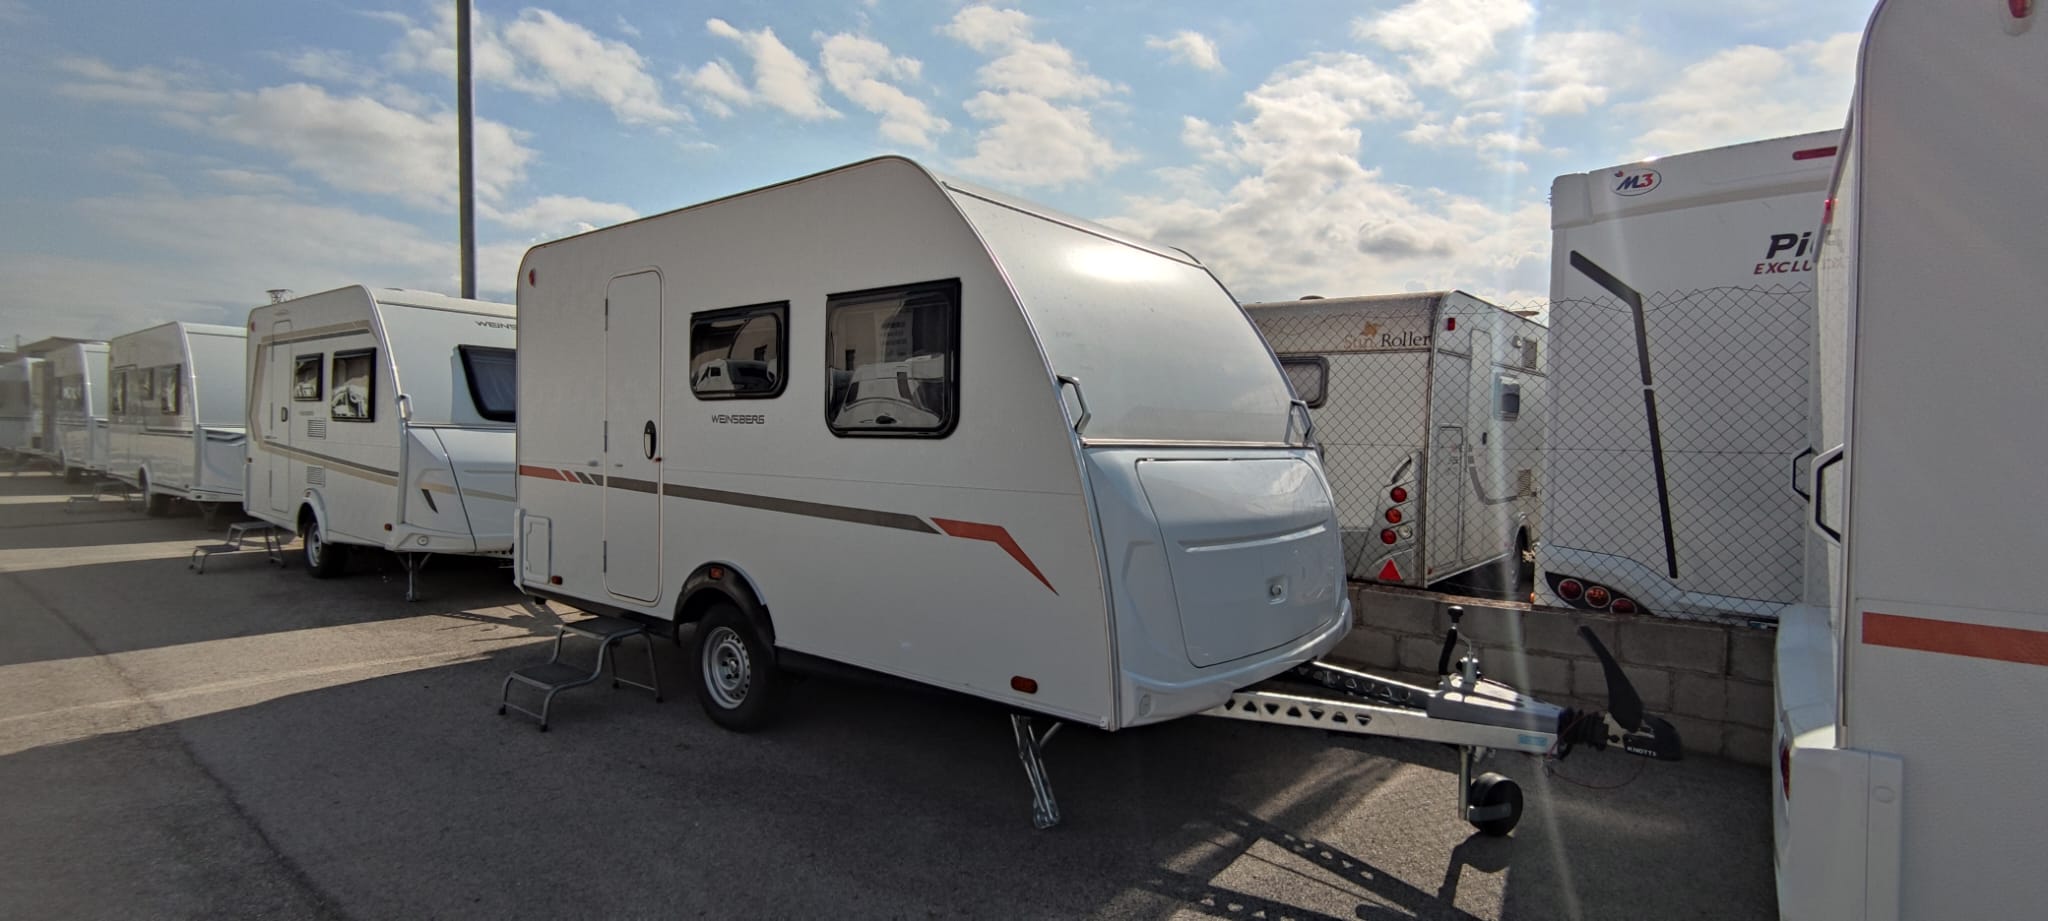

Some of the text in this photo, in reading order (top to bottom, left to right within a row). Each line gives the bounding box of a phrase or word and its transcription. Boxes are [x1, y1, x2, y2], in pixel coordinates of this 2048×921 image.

[1616, 173, 1653, 190] M3
[1766, 232, 1813, 259] Pi
[1344, 331, 1432, 350] Sun Roller
[711, 414, 765, 425] WEINSBERG
